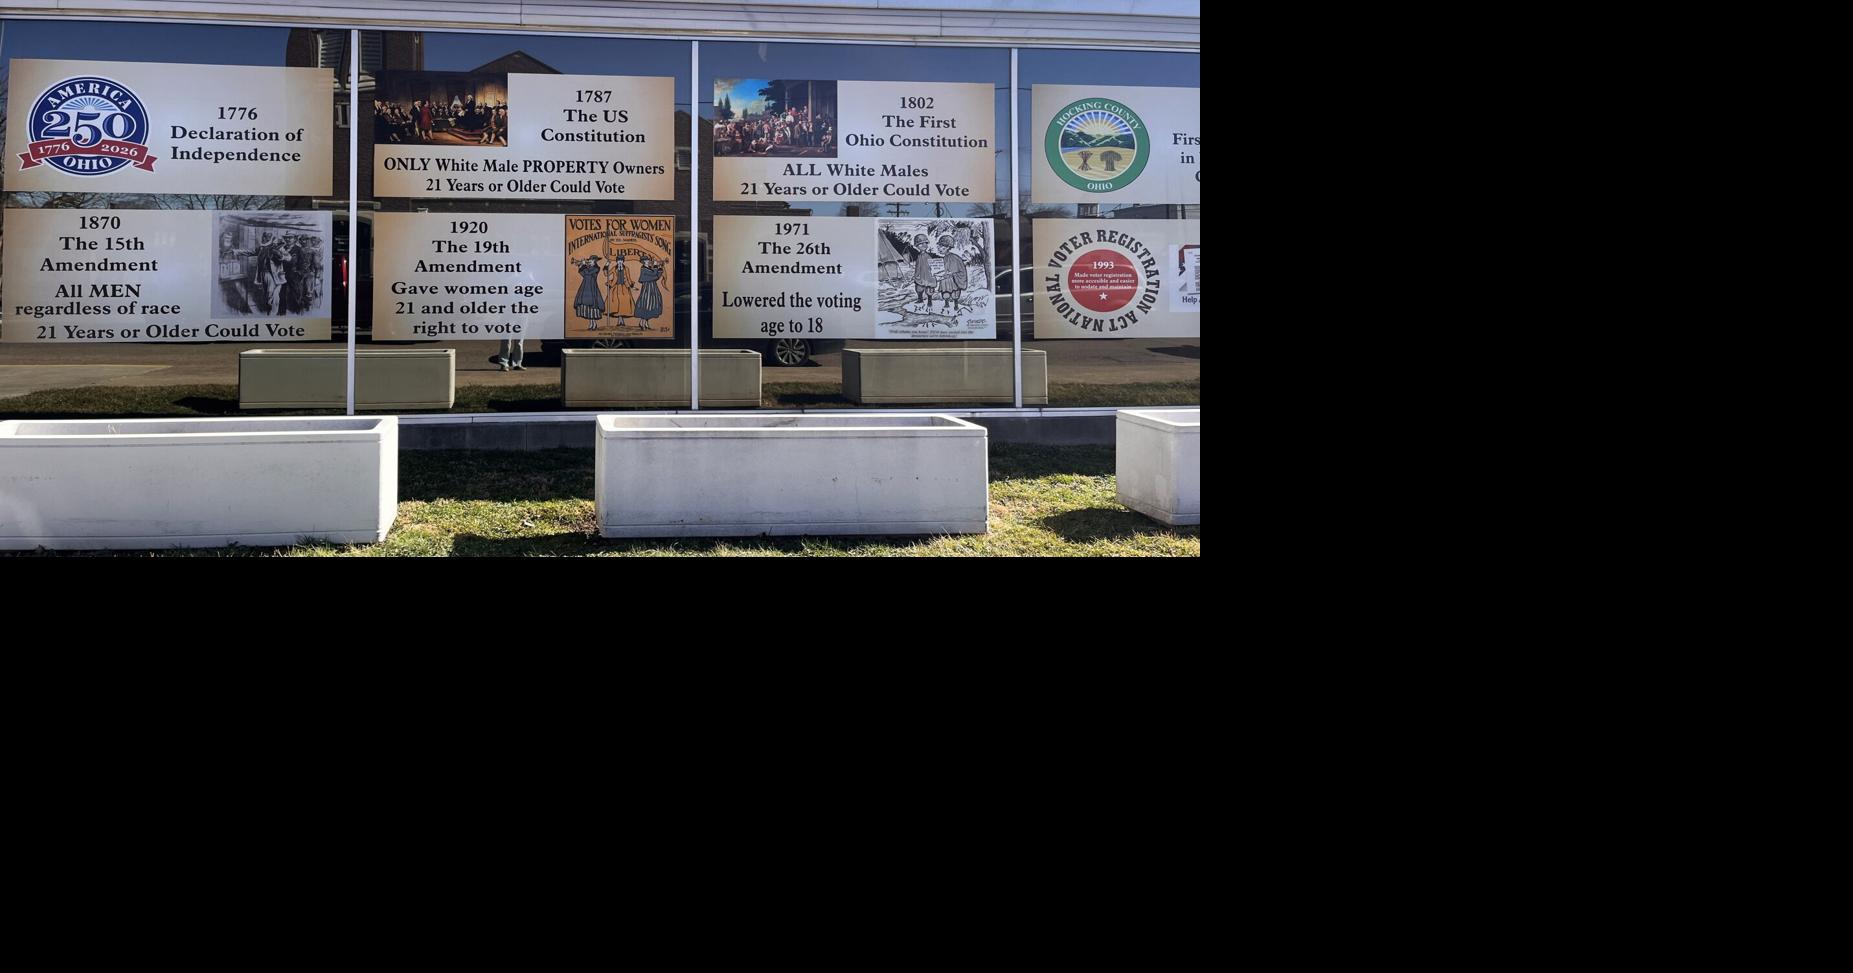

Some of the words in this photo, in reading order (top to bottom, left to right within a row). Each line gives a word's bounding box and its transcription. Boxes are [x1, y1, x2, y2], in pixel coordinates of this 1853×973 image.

[47, 82, 132, 110] AMERICA
[576, 90, 612, 103] 1787
[901, 97, 933, 109] 1802
[218, 107, 257, 120] 1776
[563, 109, 597, 122] The
[603, 110, 628, 123] US
[1057, 102, 1101, 126] HOCKING
[1104, 103, 1141, 129] COUNTY
[42, 110, 136, 146] 250
[882, 115, 914, 127] The
[920, 116, 956, 128] First
[171, 126, 279, 141] Declaration
[286, 129, 304, 141] of
[541, 129, 645, 142] Constitution
[846, 134, 884, 146] Ohio
[890, 134, 988, 147] Constitution
[38, 142, 70, 155] 1776
[101, 144, 138, 156] 2026
[171, 147, 300, 163] Independence
[63, 156, 112, 169] OHIO
[1180, 152, 1195, 163] in
[384, 157, 430, 170] ONLY
[435, 158, 478, 171] White
[483, 159, 518, 172] Male
[523, 160, 609, 173] PROPERTY
[613, 161, 664, 174] Owners
[783, 164, 821, 176] ALL
[827, 164, 875, 176] White
[880, 165, 928, 177] Males
[426, 179, 441, 191] 21
[446, 179, 484, 191] Years
[489, 183, 503, 192] or
[507, 180, 546, 192] Older
[550, 180, 590, 193] Could
[595, 181, 624, 193] Vote
[741, 183, 757, 194] 21
[764, 183, 806, 195] Years
[812, 187, 828, 195] or
[834, 183, 878, 195] Older
[883, 184, 930, 196] Could
[935, 184, 969, 196] Vote
[1087, 182, 1112, 190] OHIO
[80, 216, 120, 229] 1870
[451, 221, 488, 233] 1920
[569, 219, 601, 230] VOTES
[606, 219, 627, 230] FOR
[630, 220, 671, 231] WOMEN
[776, 223, 809, 235] 1971
[59, 237, 97, 250] The
[106, 237, 144, 250] 15th
[432, 240, 467, 253] The
[475, 241, 509, 253] 19th
[655, 236, 671, 255] SONG
[758, 242, 791, 254] The
[796, 243, 830, 254] 26th
[1048, 232, 1093, 268] VOTER
[40, 258, 157, 271] Amendment
[415, 260, 521, 272] Amendment
[742, 261, 842, 274] Amendment
[1093, 261, 1114, 269] 1993
[1097, 230, 1160, 314] REGISTRATION
[55, 285, 82, 297] All
[89, 284, 141, 297] MEN
[392, 282, 438, 294] Gave
[444, 286, 508, 294] women
[514, 286, 543, 297] age
[722, 292, 785, 307] Lowered
[790, 292, 812, 307] the
[817, 292, 861, 312] voting
[1046, 274, 1104, 332] NATIONAL
[1182, 296, 1197, 304] Help
[16, 302, 111, 318] regardless
[117, 301, 137, 314] of
[141, 305, 180, 314] race
[396, 302, 414, 314] 21
[421, 302, 454, 314] and
[460, 302, 506, 314] older
[511, 301, 538, 313] the
[761, 322, 784, 336] age
[789, 320, 802, 333] to
[808, 318, 823, 333] 18
[1109, 310, 1138, 331] ACT
[37, 326, 56, 339] 21
[64, 326, 114, 339] Years
[121, 329, 140, 338] or
[146, 325, 199, 338] Older
[205, 324, 259, 337] Could
[265, 324, 304, 336] Vote
[413, 321, 455, 337] right
[462, 323, 478, 333] to
[485, 323, 521, 333] vote
